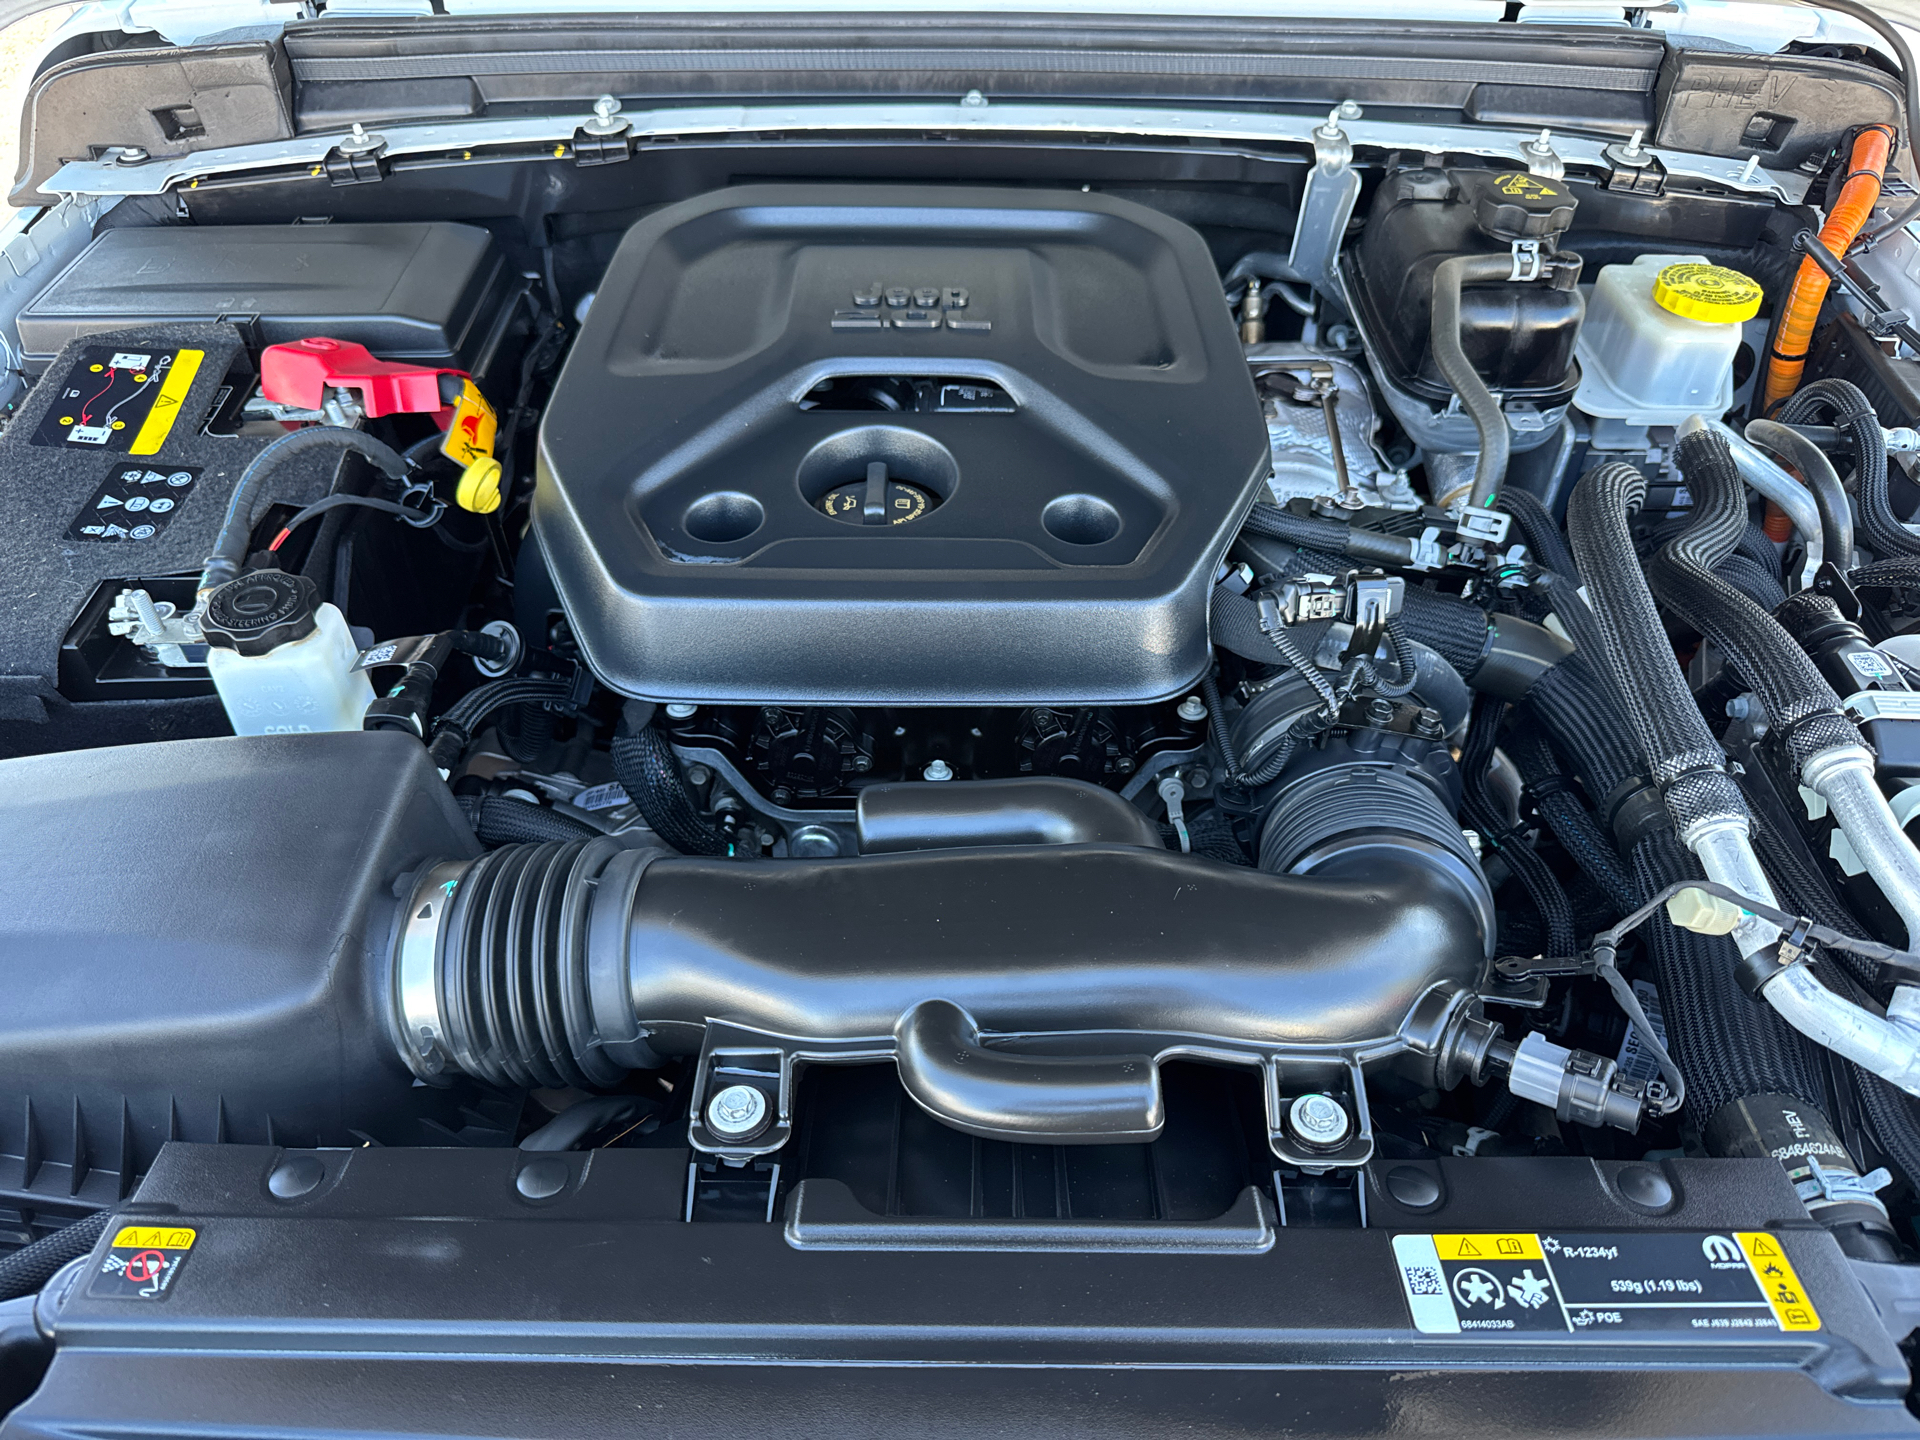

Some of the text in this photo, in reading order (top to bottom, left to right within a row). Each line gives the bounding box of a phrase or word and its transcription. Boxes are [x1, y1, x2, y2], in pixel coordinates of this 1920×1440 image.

[1682, 75, 1798, 109] PHEV
[853, 282, 969, 309] Jeep
[831, 310, 991, 331] 2.0L
[227, 612, 278, 628] STEERING
[1781, 1109, 1810, 1138] PHEV
[1563, 1246, 1619, 1260] R-1234yf
[1610, 1279, 1703, 1294] 539g (1.19 lbs)
[1461, 1319, 1516, 1329] 68414033AB
[1596, 1312, 1623, 1324] POE
